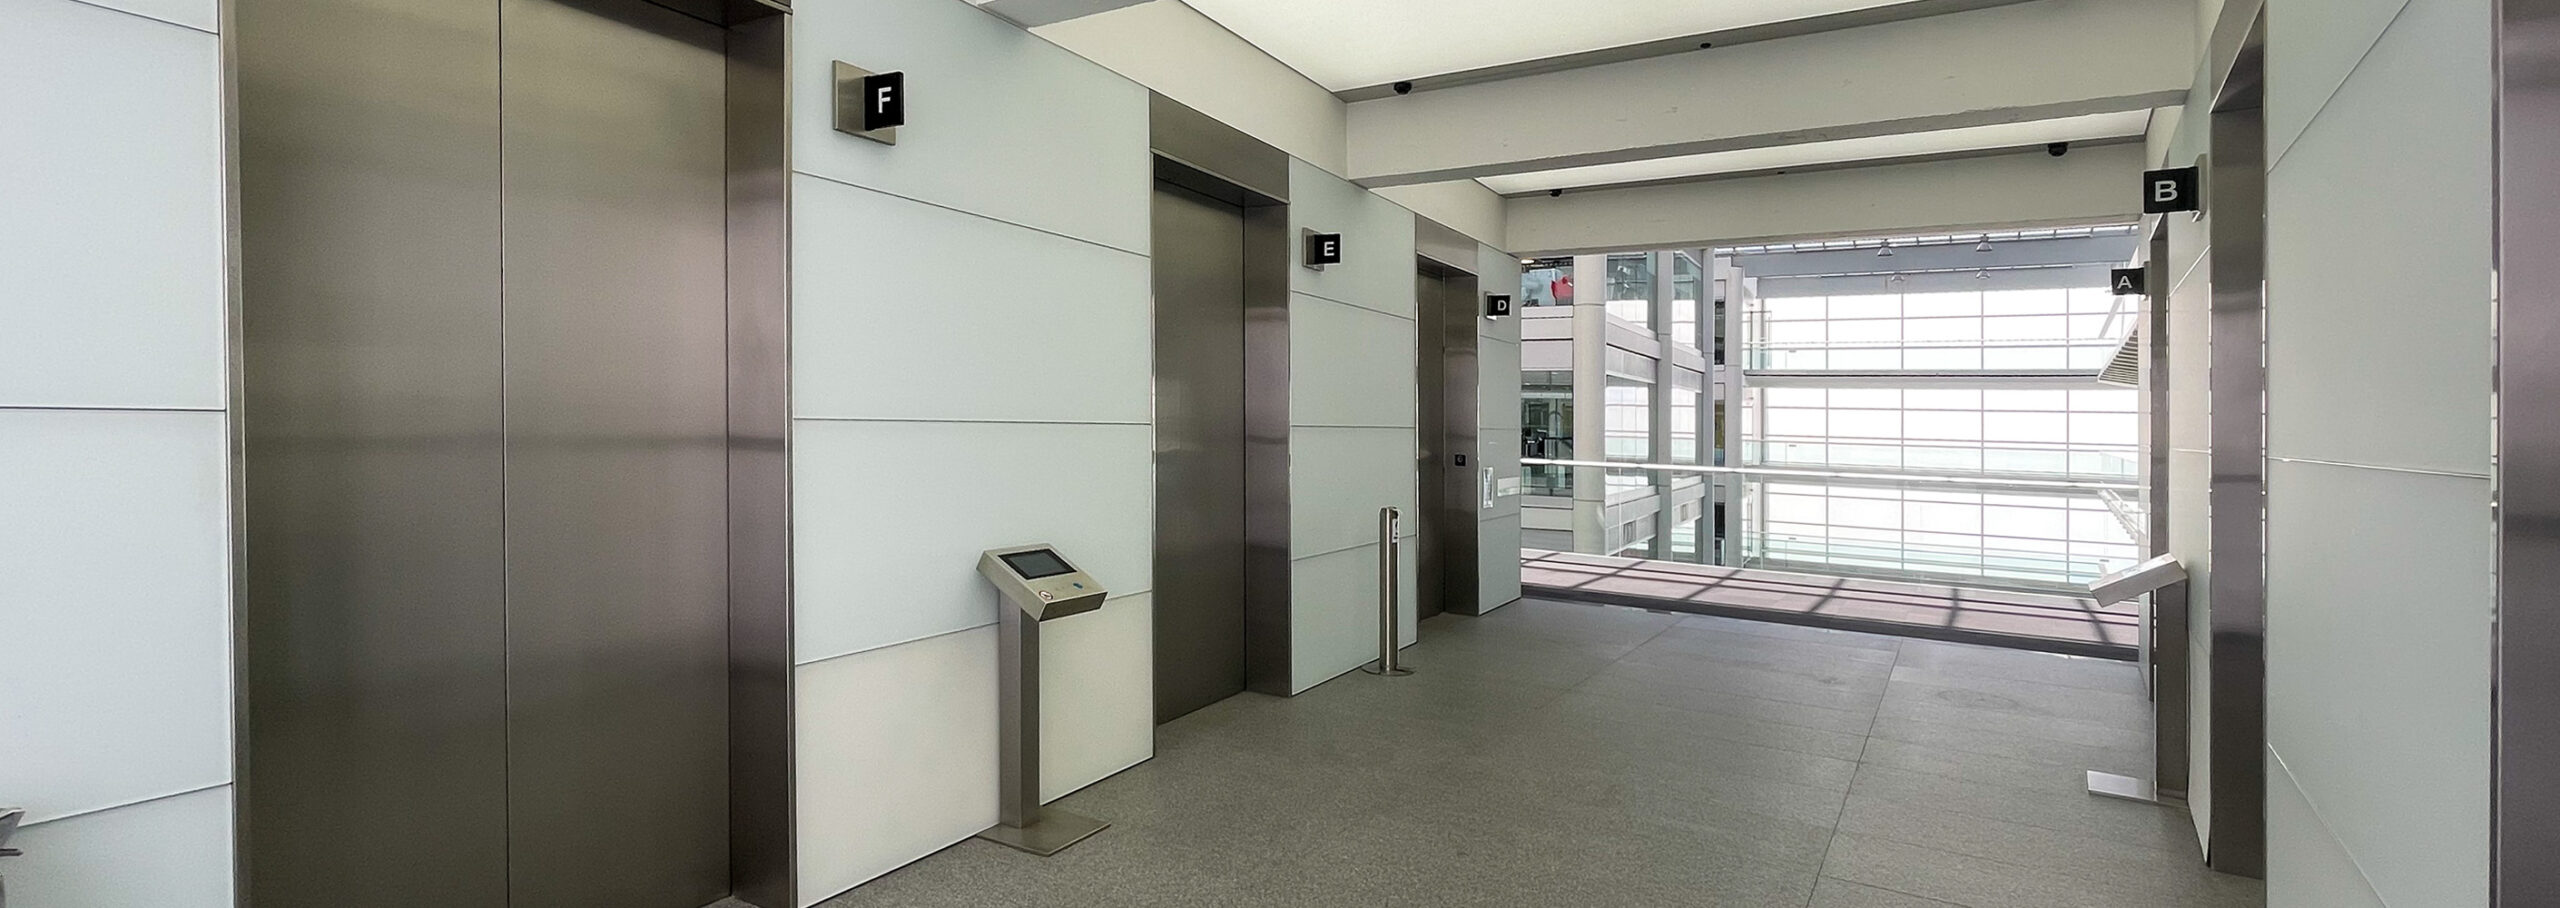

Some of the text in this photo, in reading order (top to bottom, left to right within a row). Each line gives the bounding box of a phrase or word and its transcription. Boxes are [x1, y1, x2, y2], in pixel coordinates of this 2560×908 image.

[878, 86, 892, 114] F
[2154, 180, 2178, 202] B
[1324, 241, 1335, 257] E
[2116, 275, 2133, 289] A
[1497, 299, 1507, 311] D
